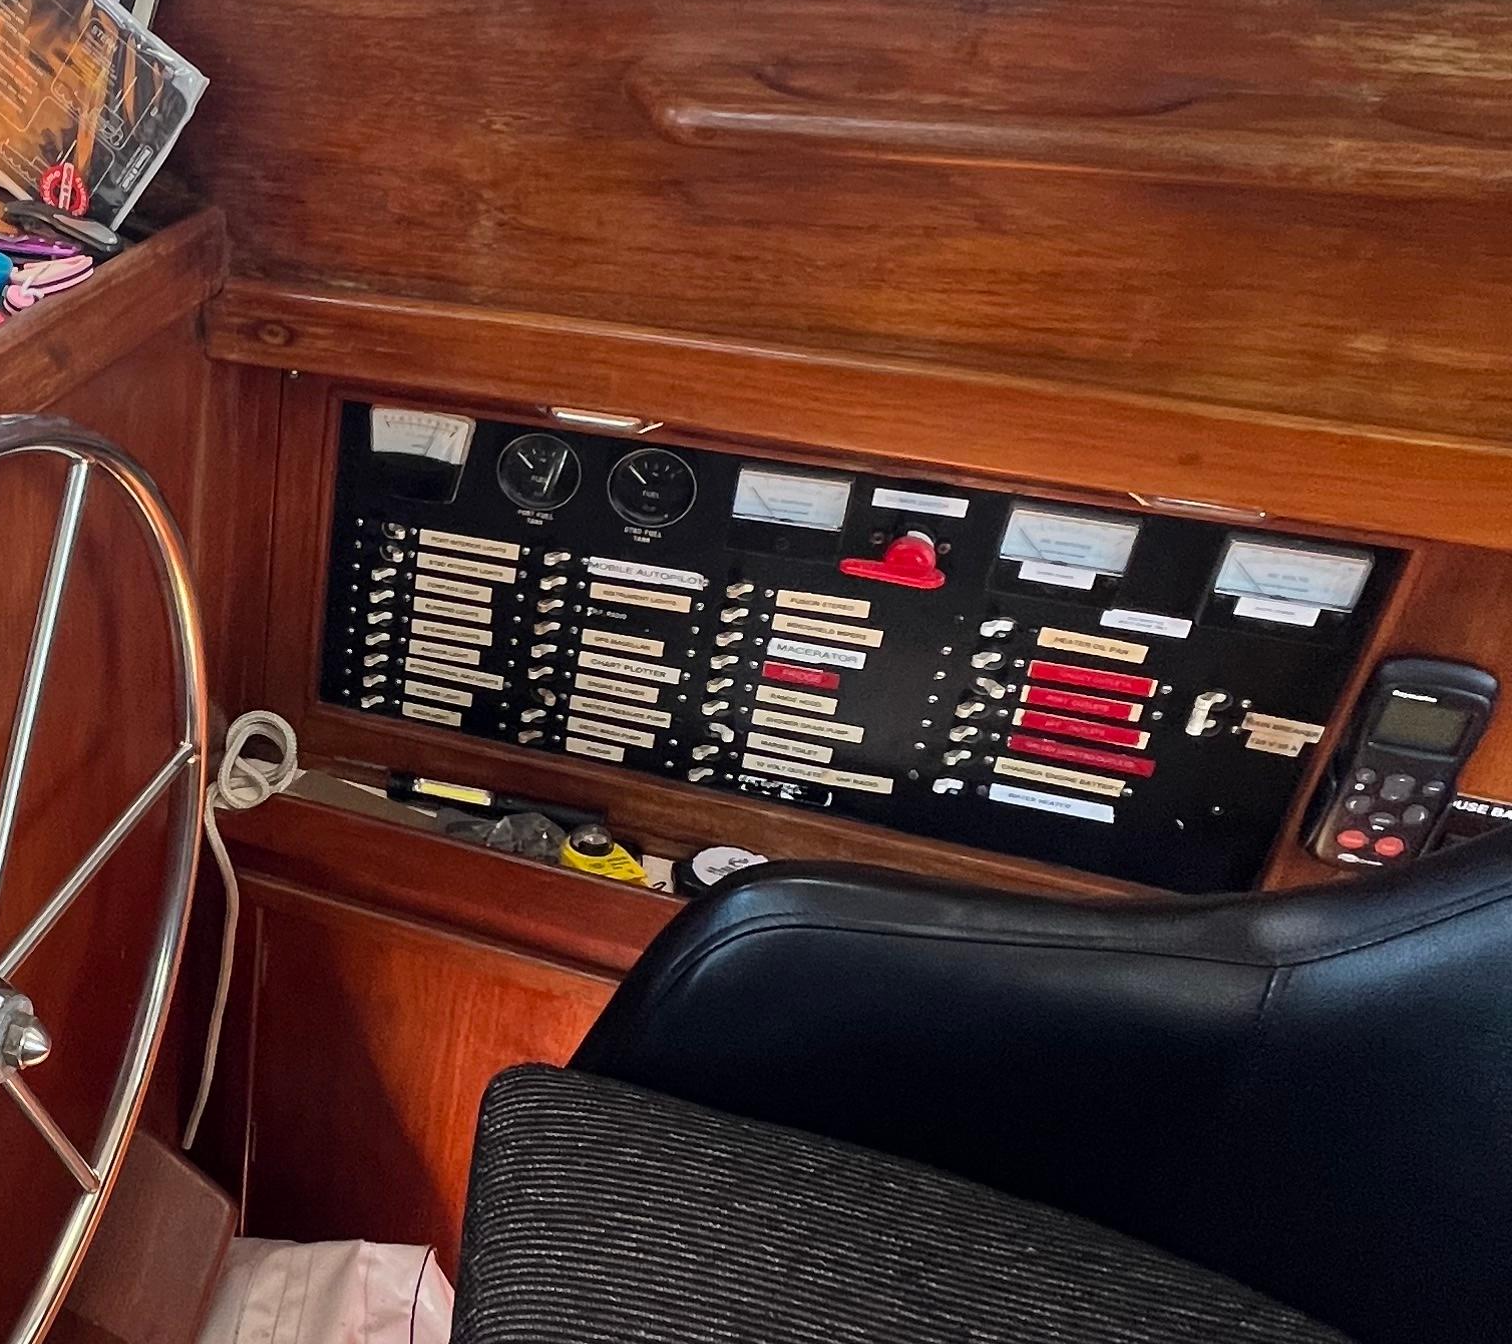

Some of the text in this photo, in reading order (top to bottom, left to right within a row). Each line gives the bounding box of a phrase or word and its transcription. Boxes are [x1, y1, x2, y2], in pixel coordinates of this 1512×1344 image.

[588, 561, 634, 575] MOBILE
[776, 643, 858, 664] MACERATOR
[590, 658, 667, 678] CHART PLOTTER
